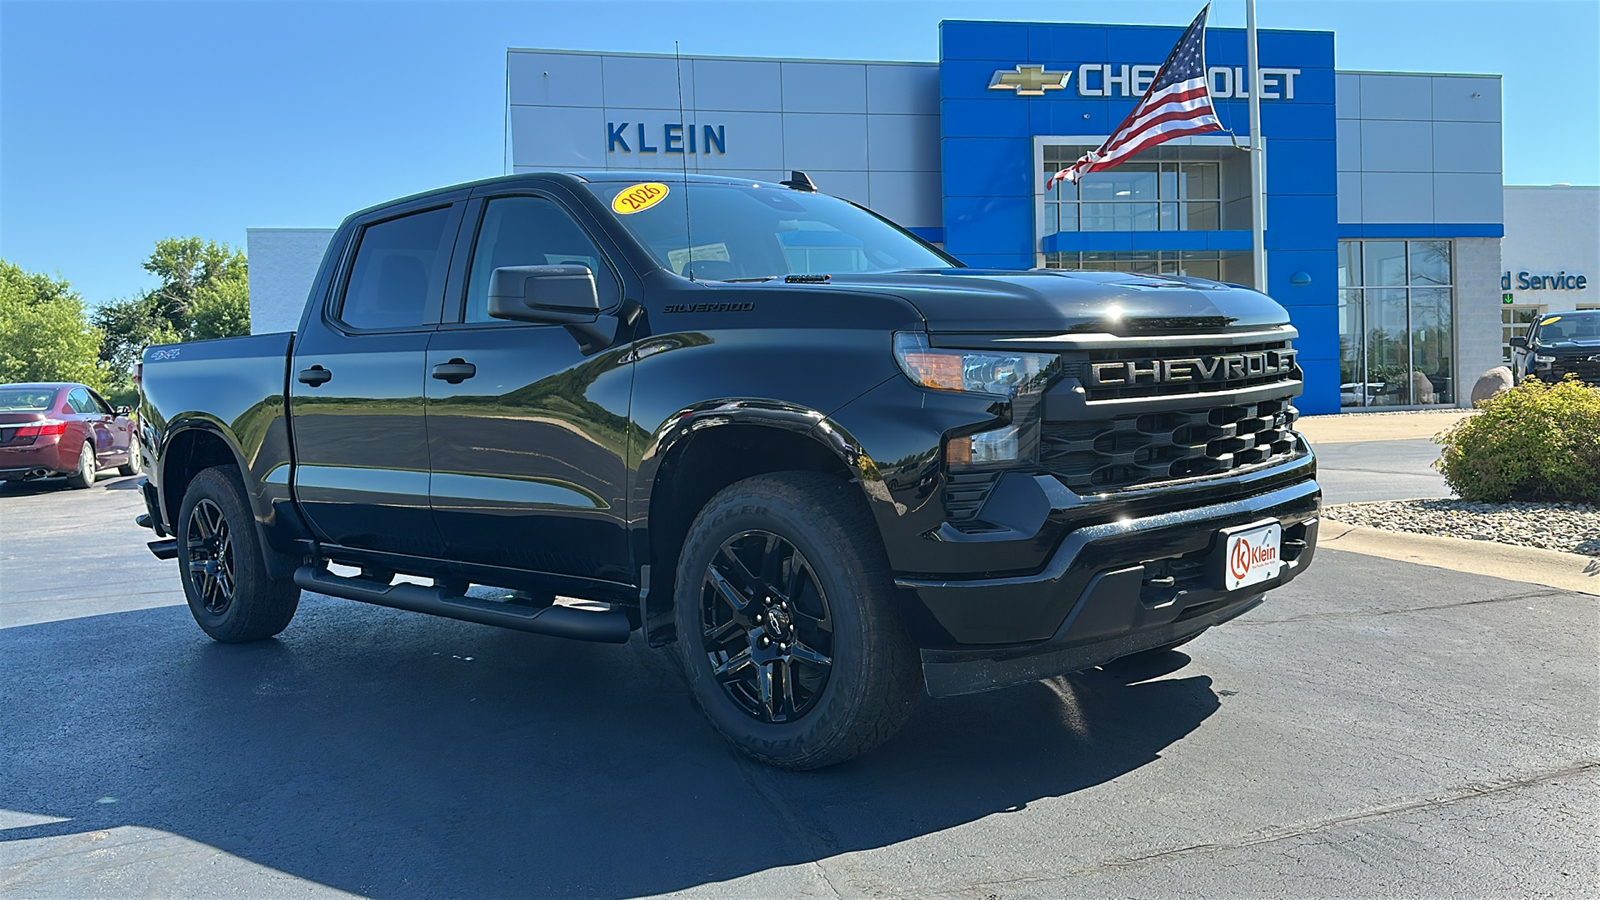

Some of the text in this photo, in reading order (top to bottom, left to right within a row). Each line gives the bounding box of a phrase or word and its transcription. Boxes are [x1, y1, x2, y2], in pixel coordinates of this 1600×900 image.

[1079, 64, 1301, 99] CHEOLET
[607, 122, 726, 154] KLEIN
[621, 184, 661, 210] 2026
[1518, 271, 1587, 290] Service
[662, 302, 757, 314] SILVERADO
[1251, 543, 1276, 565] Klein
